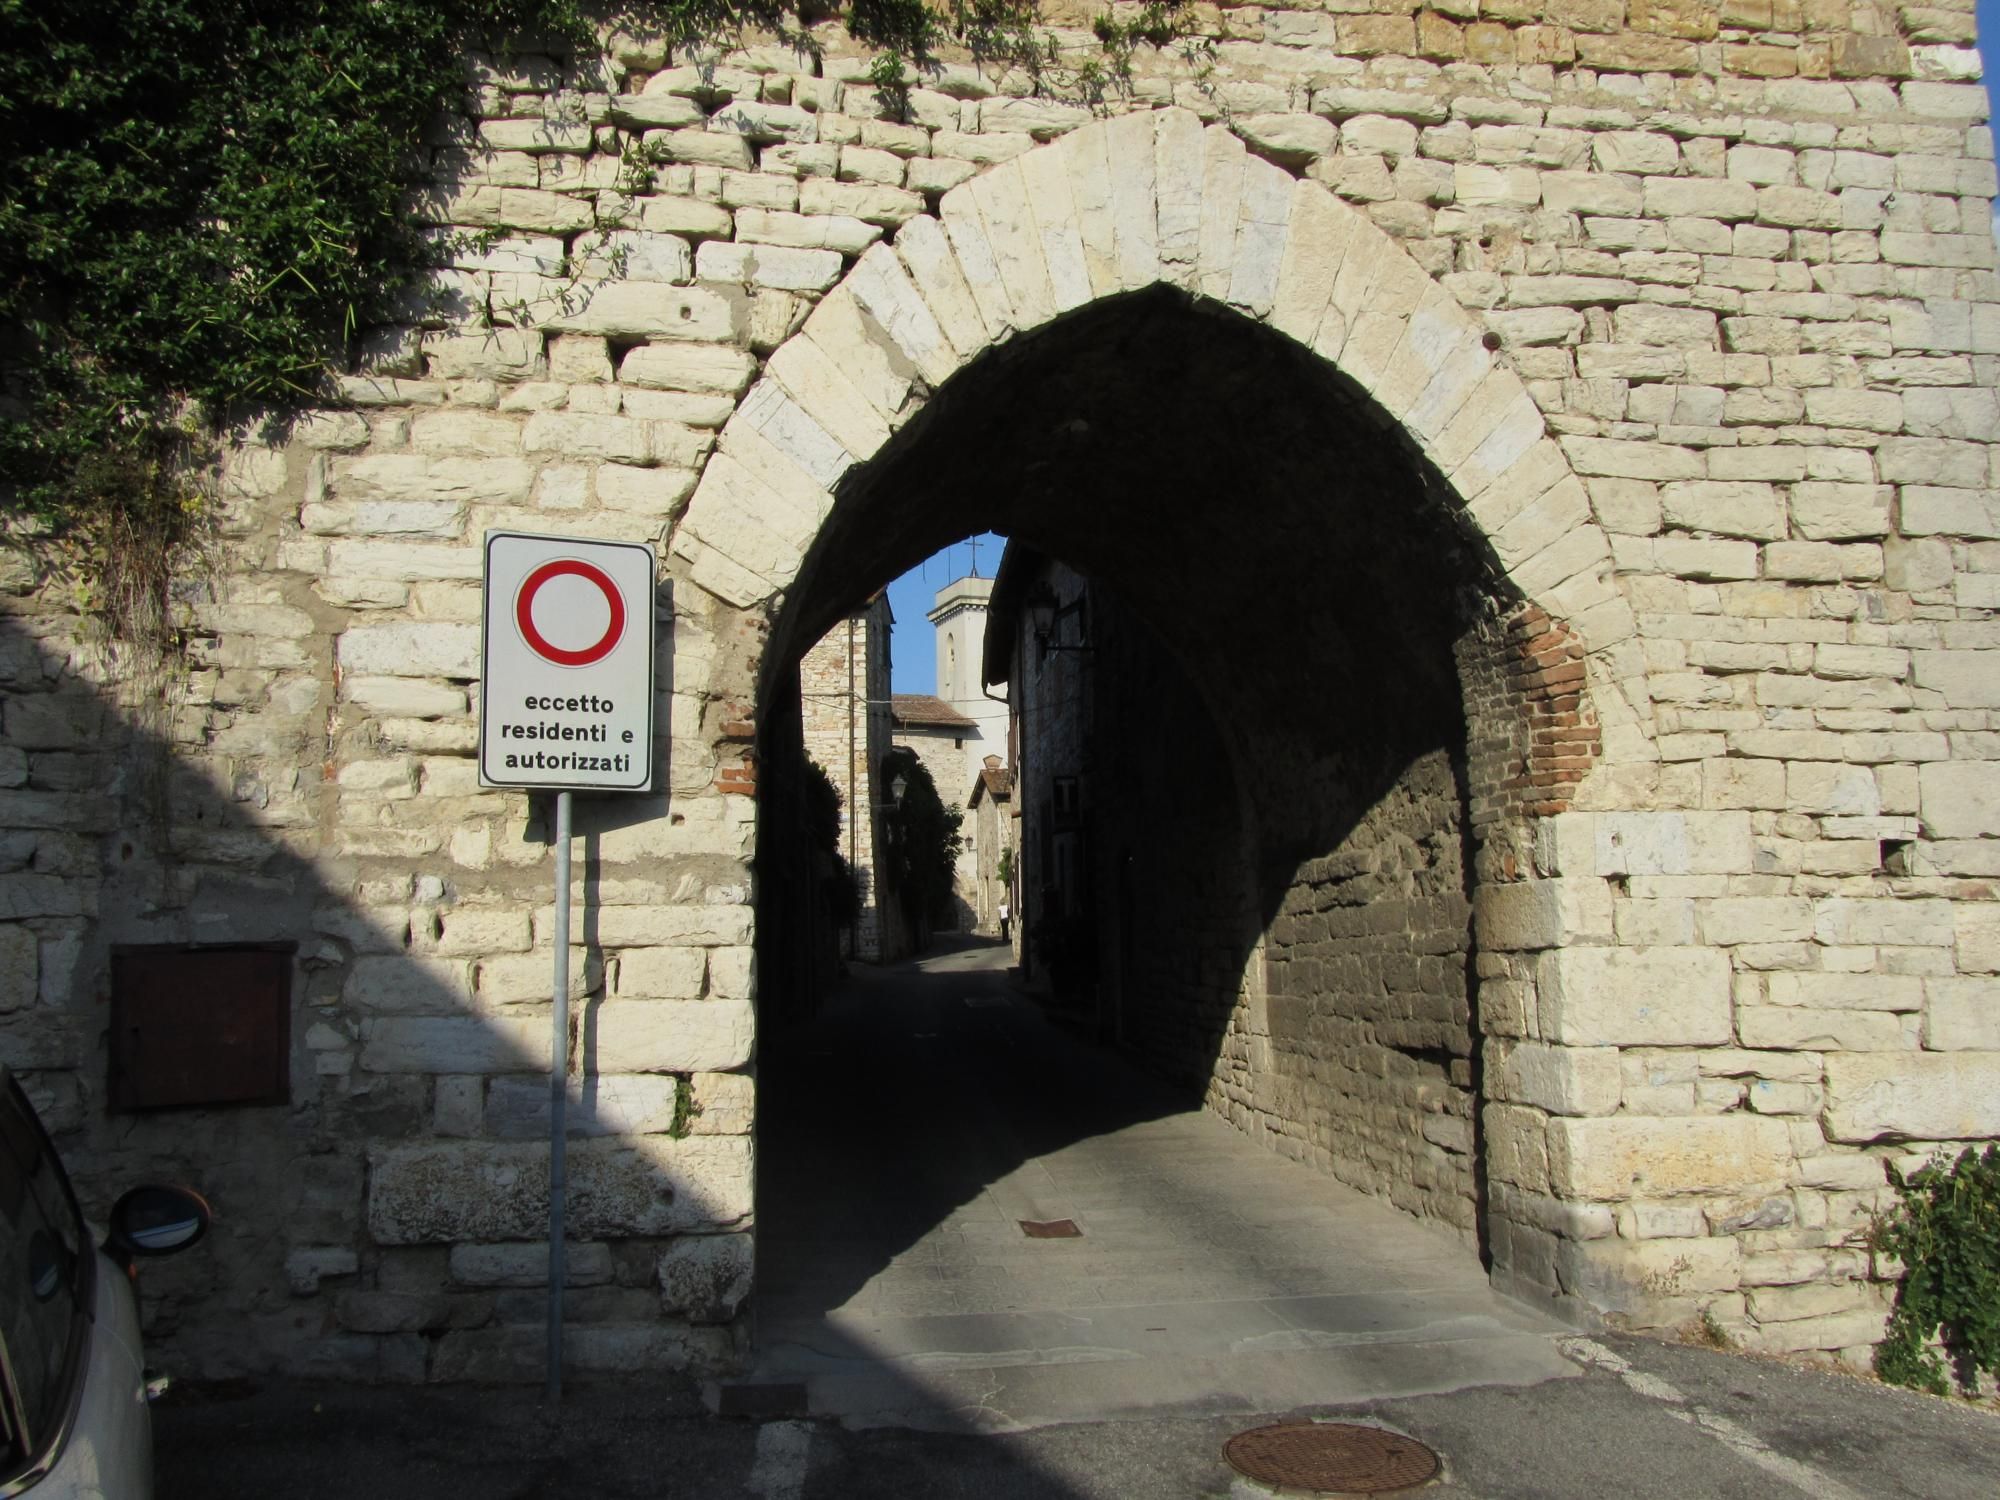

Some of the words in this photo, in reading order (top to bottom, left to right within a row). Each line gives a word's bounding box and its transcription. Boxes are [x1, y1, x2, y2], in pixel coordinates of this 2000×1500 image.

[524, 694, 614, 714] eccetto
[502, 721, 606, 742] residenti
[620, 730, 634, 744] e
[505, 751, 630, 771] autorizzati
